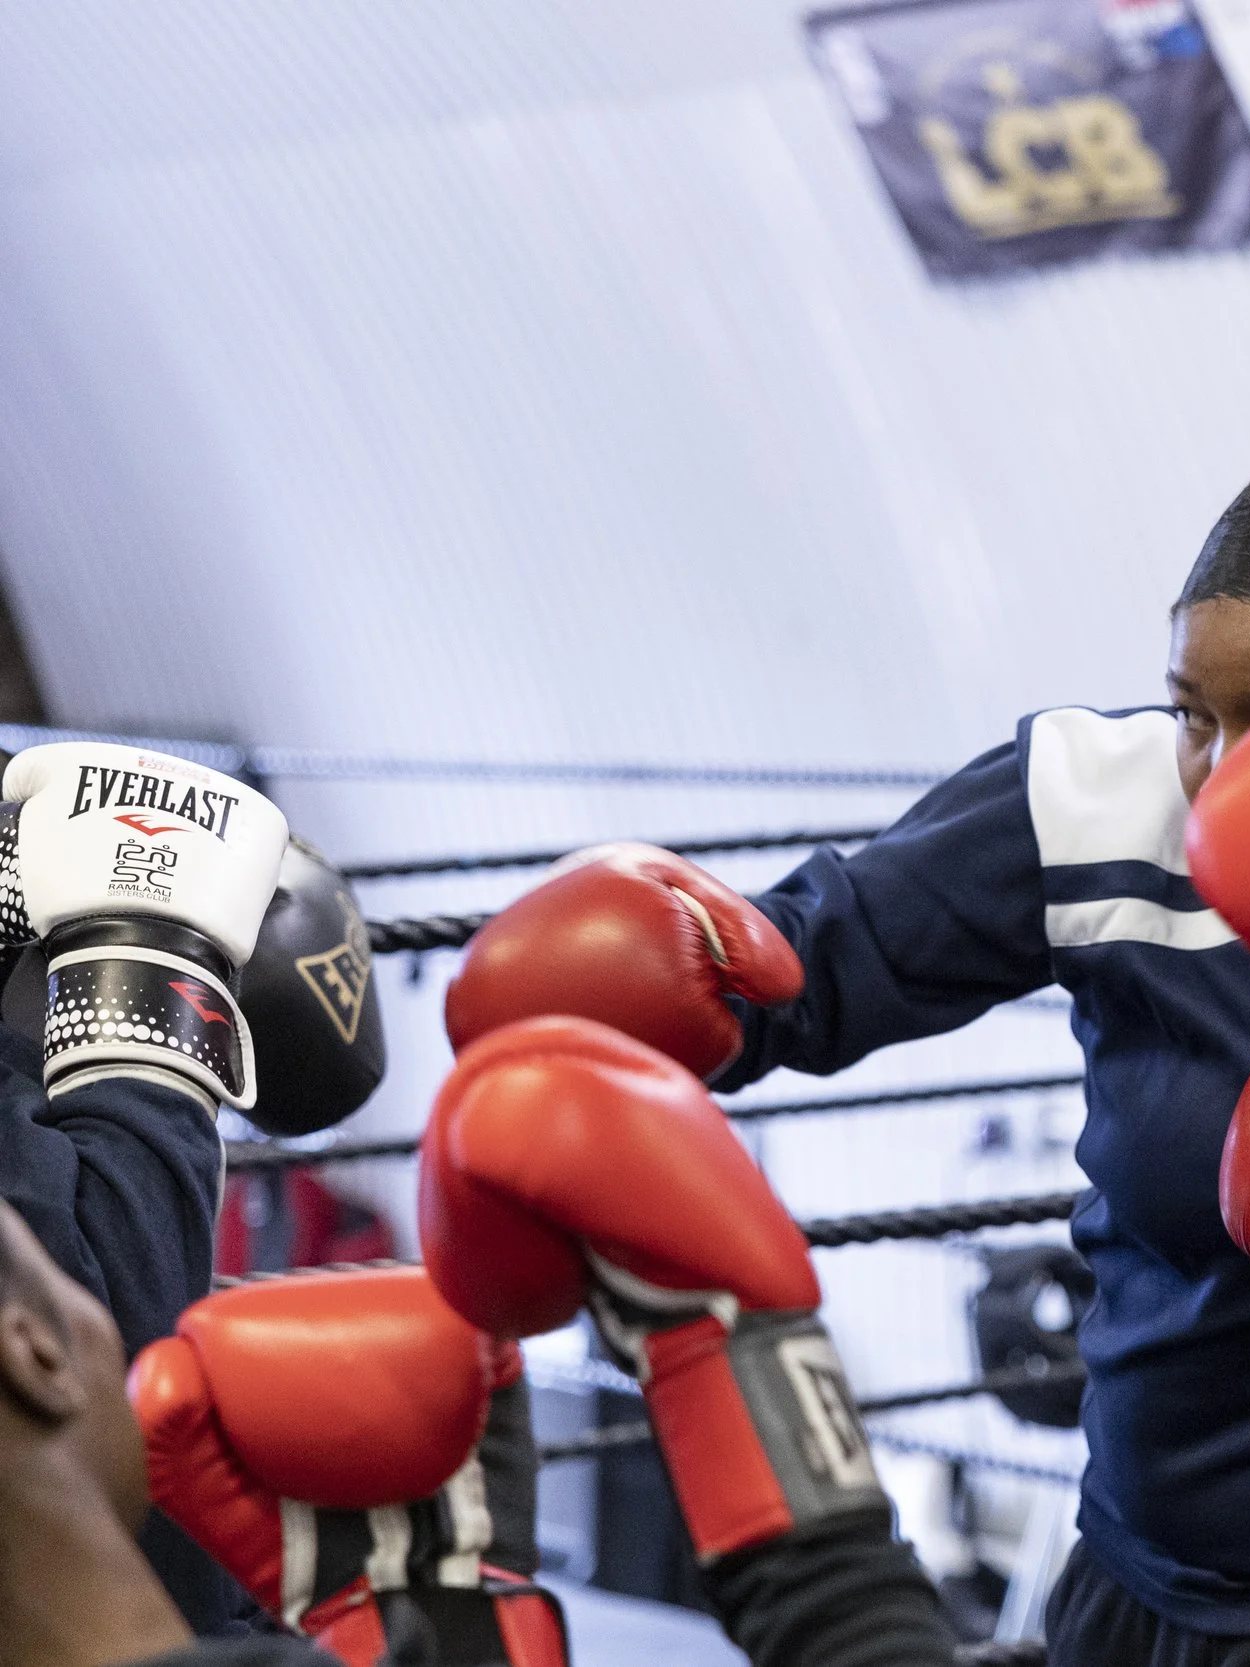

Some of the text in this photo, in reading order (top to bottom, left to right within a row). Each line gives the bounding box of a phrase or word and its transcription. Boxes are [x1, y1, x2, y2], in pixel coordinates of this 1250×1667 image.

[68, 765, 239, 843] EVERLAST
[107, 890, 170, 903] SISTERS CLUB
[108, 883, 172, 897] RAMLA ALI
